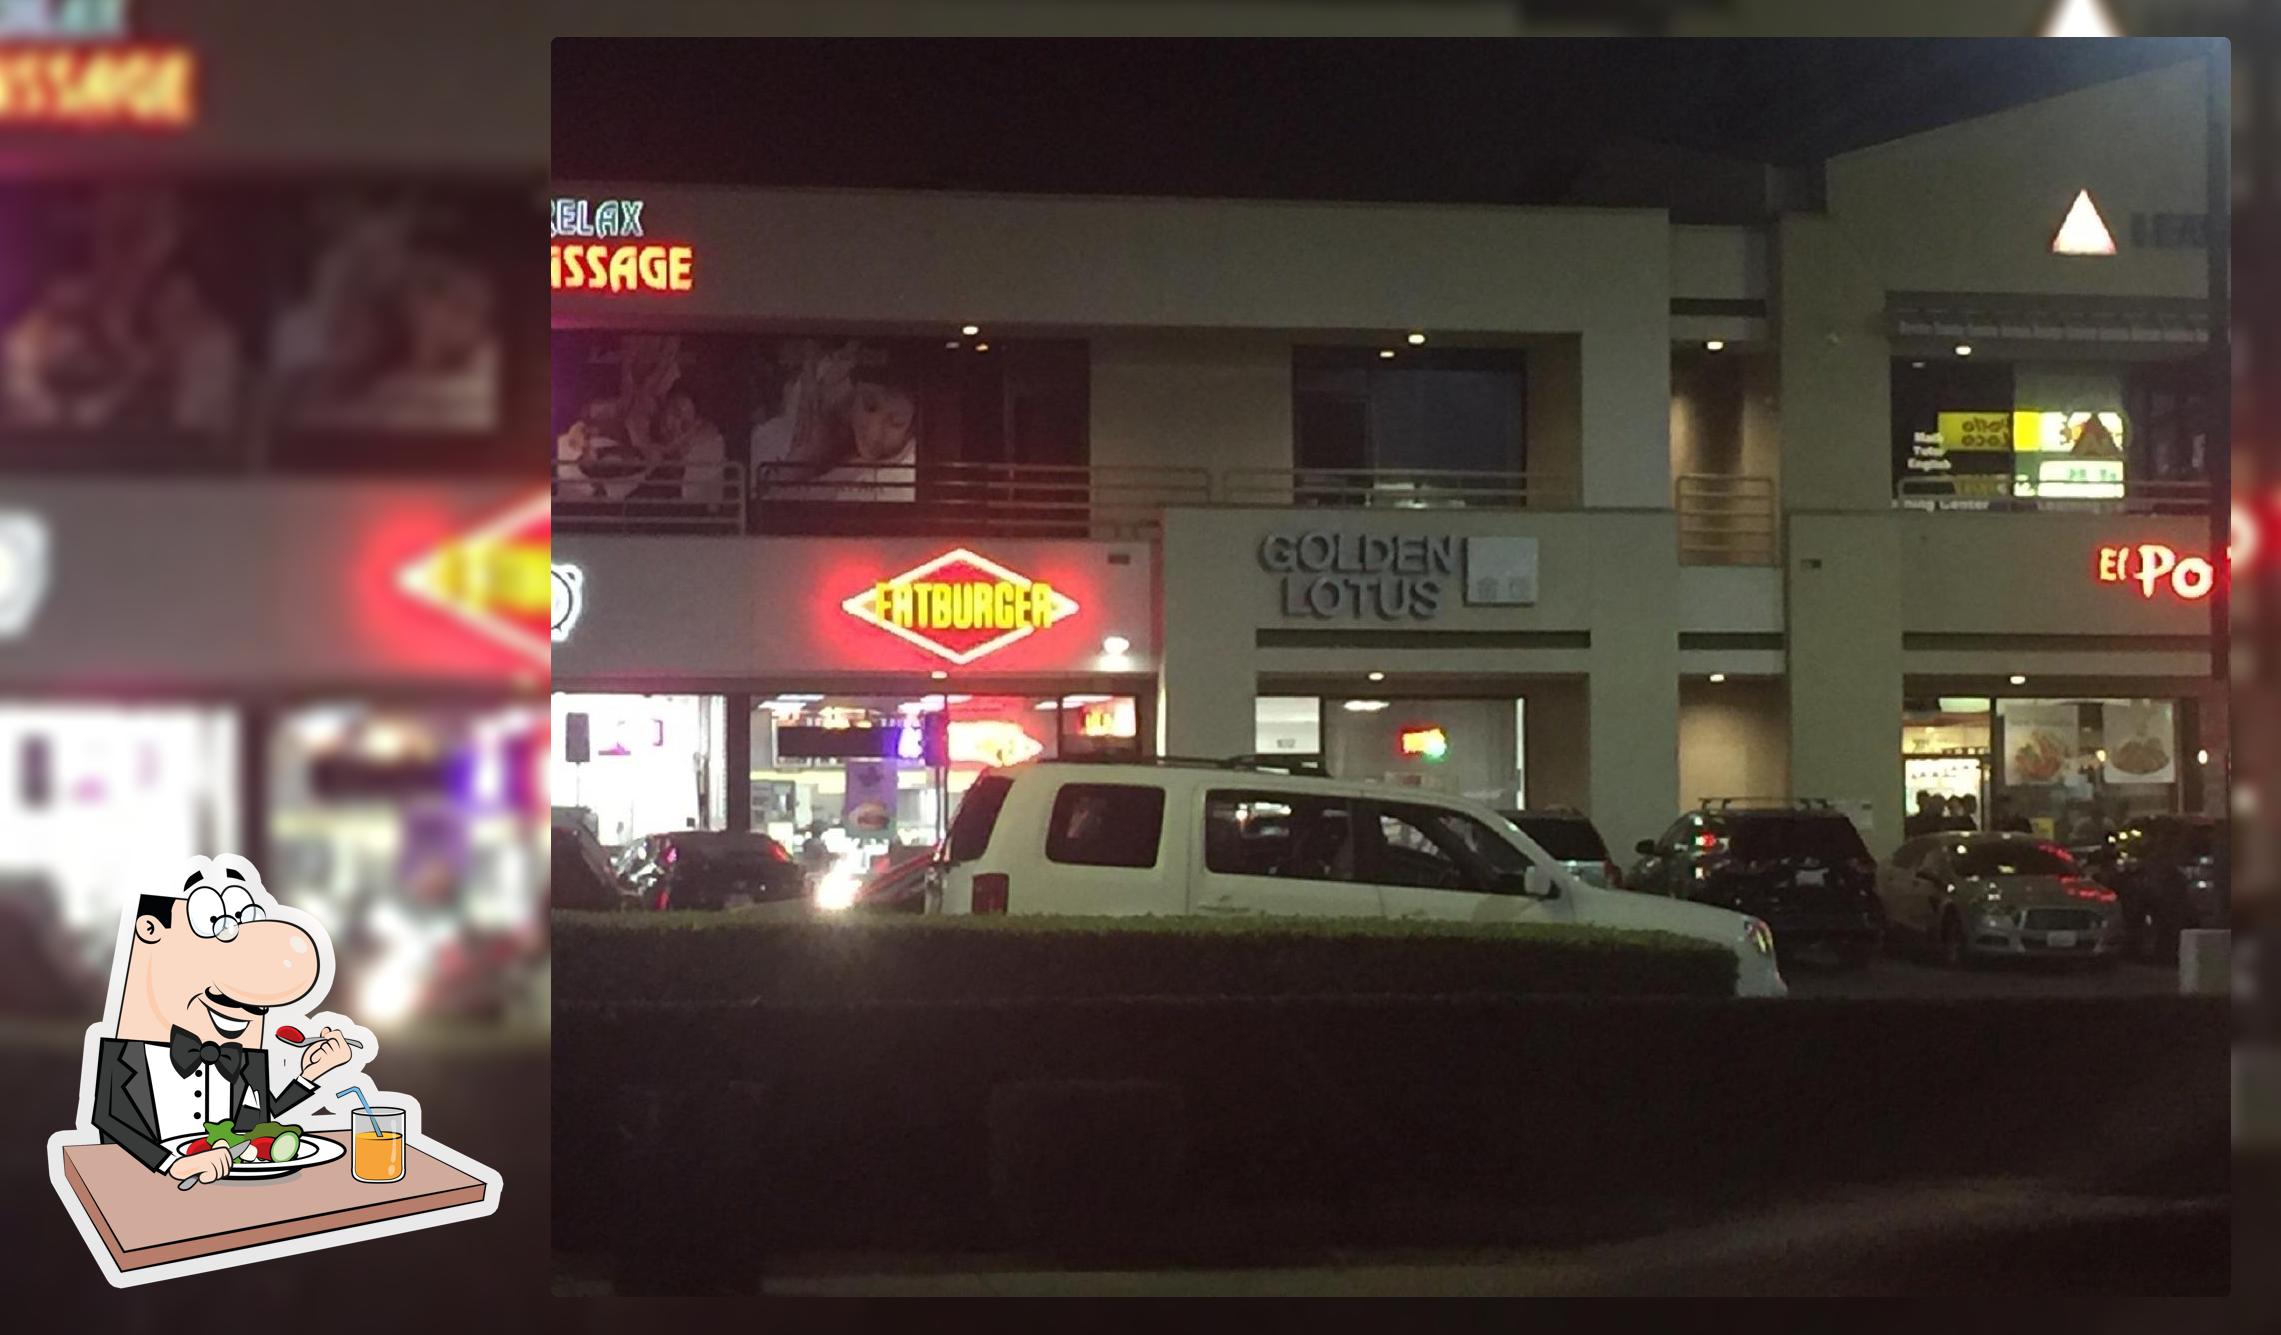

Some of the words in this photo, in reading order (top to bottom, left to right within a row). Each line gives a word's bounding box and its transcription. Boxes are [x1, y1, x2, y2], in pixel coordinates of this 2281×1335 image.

[1258, 532, 1461, 574] GOLDEN
[2133, 544, 2215, 598] Po
[875, 581, 1053, 629] FATBURGER
[1281, 575, 1446, 620] LOTUS
